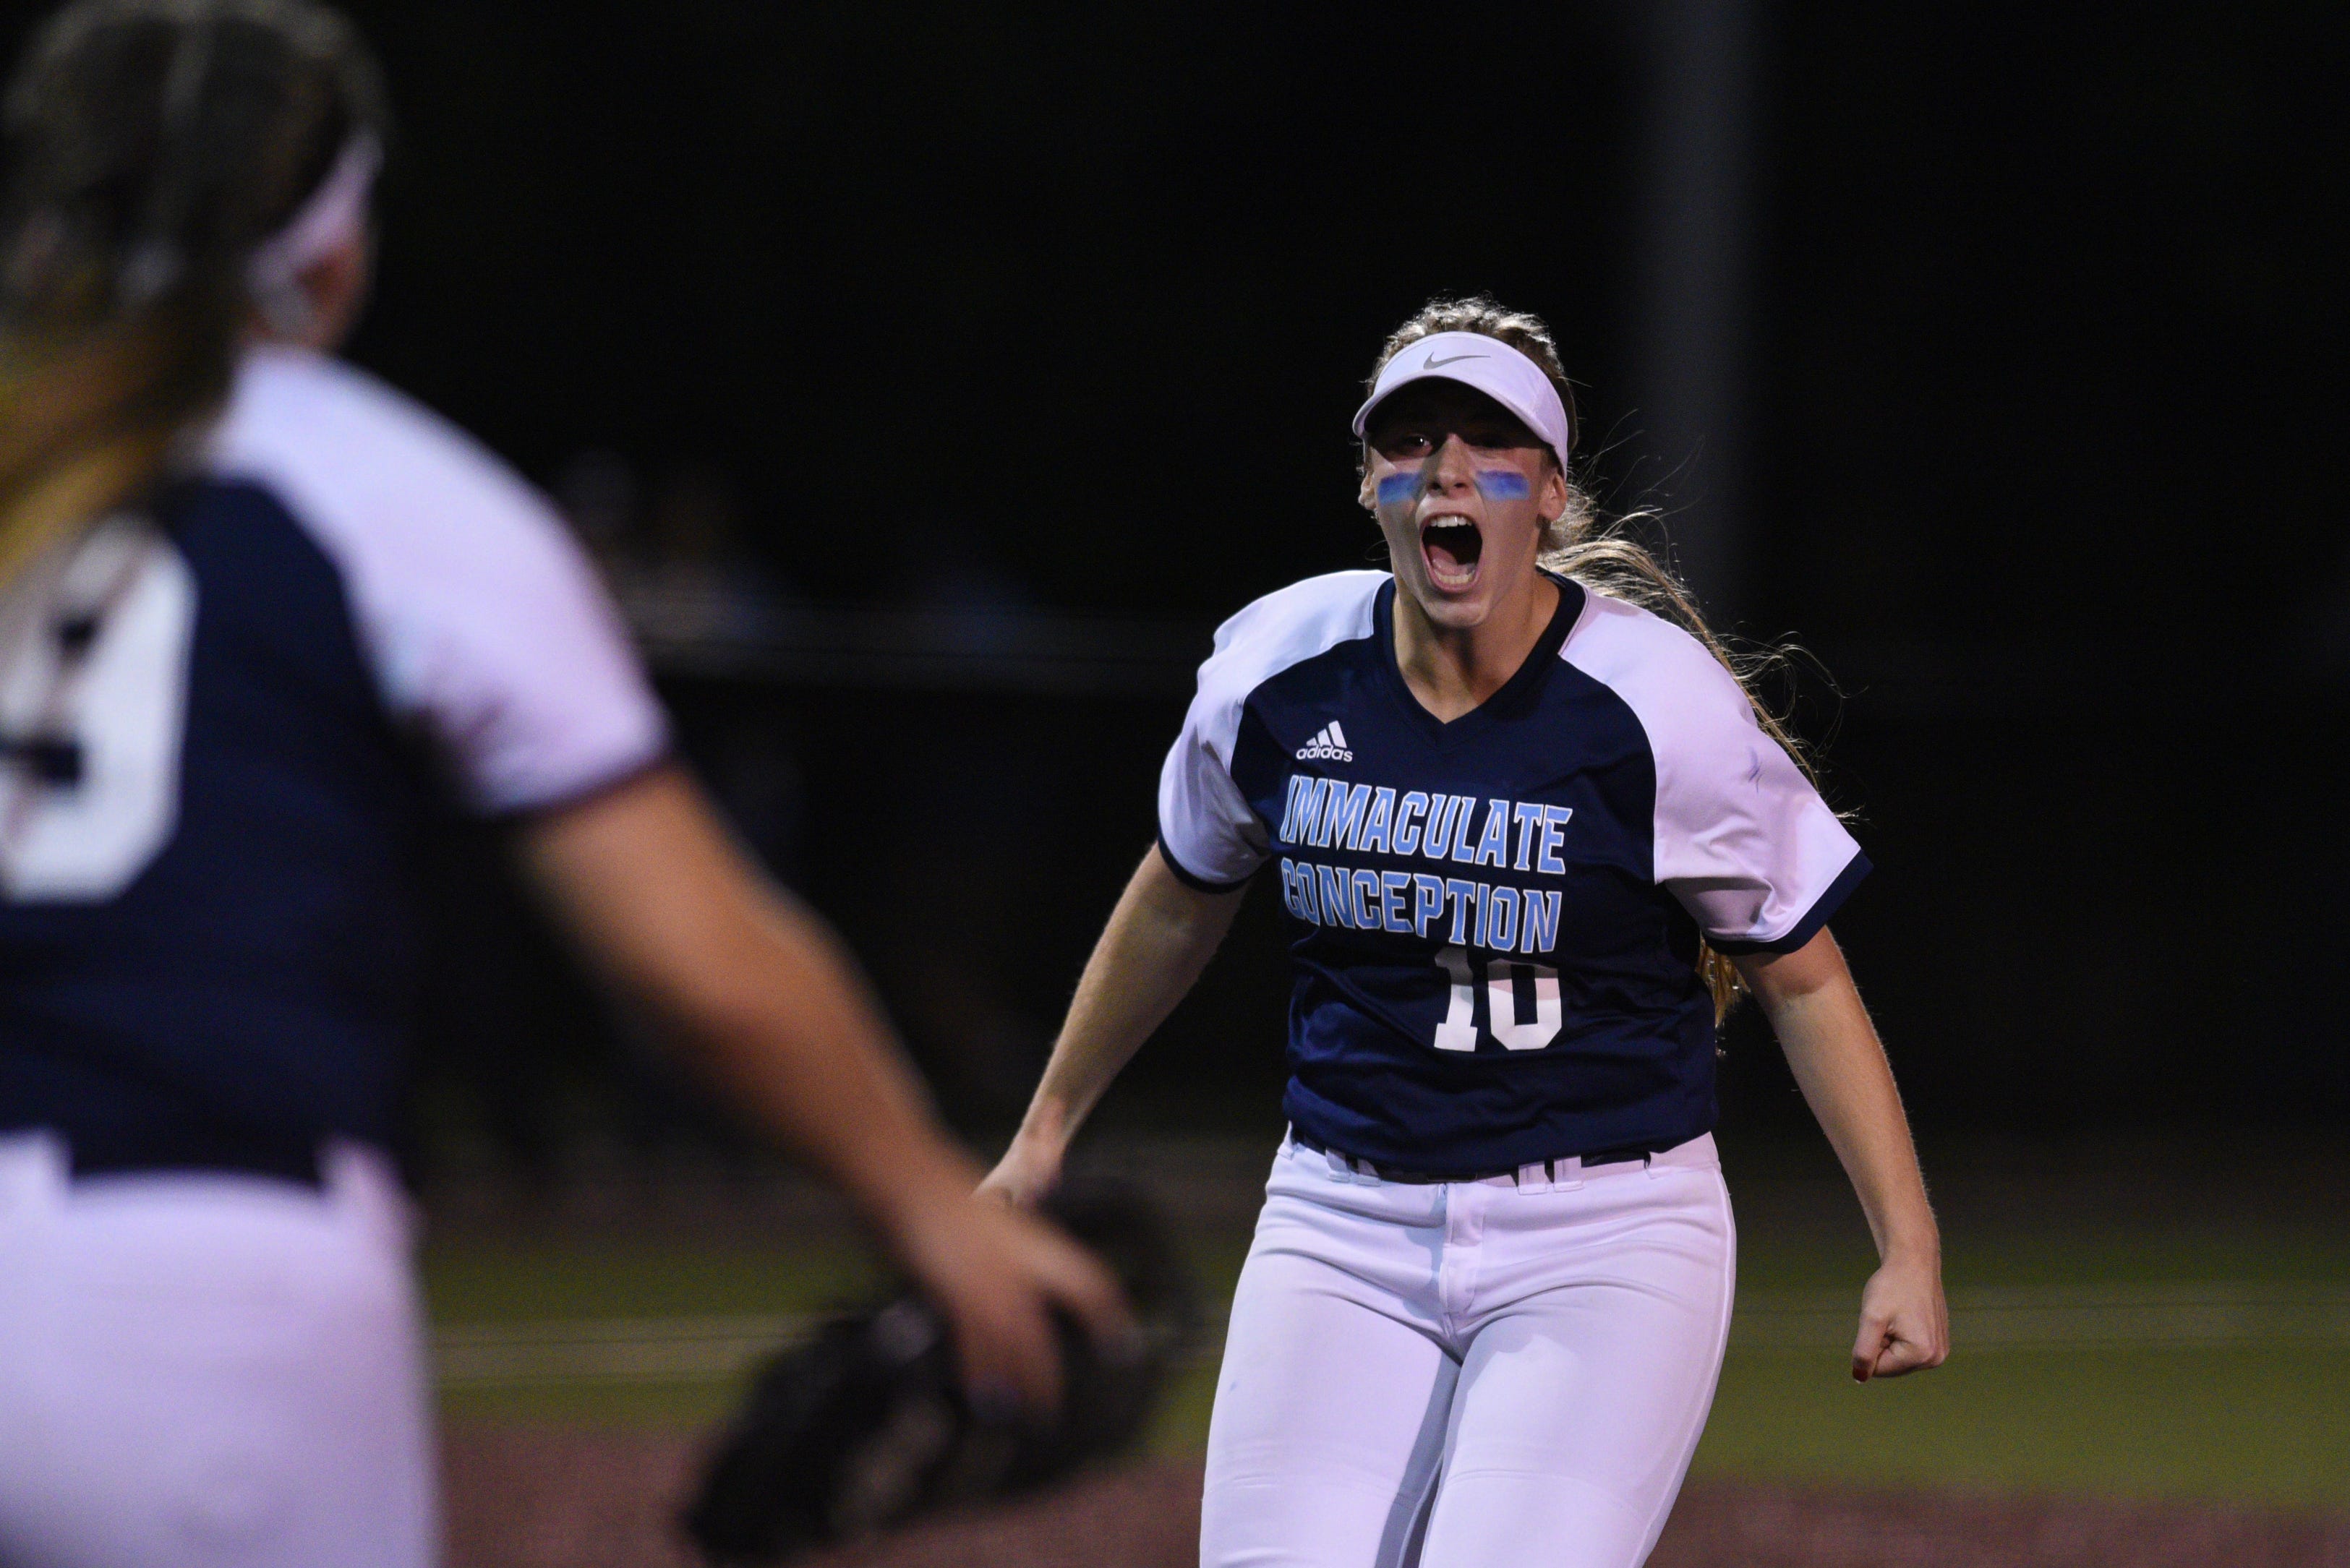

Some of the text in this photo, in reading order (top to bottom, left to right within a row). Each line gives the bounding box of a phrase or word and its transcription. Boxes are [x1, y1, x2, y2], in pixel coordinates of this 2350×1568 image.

[1296, 744, 1353, 763] adidas
[1279, 774, 1573, 875] IMMACULATE
[1280, 857, 1563, 954] CONCEPTION
[1434, 946, 1562, 1053] 10
